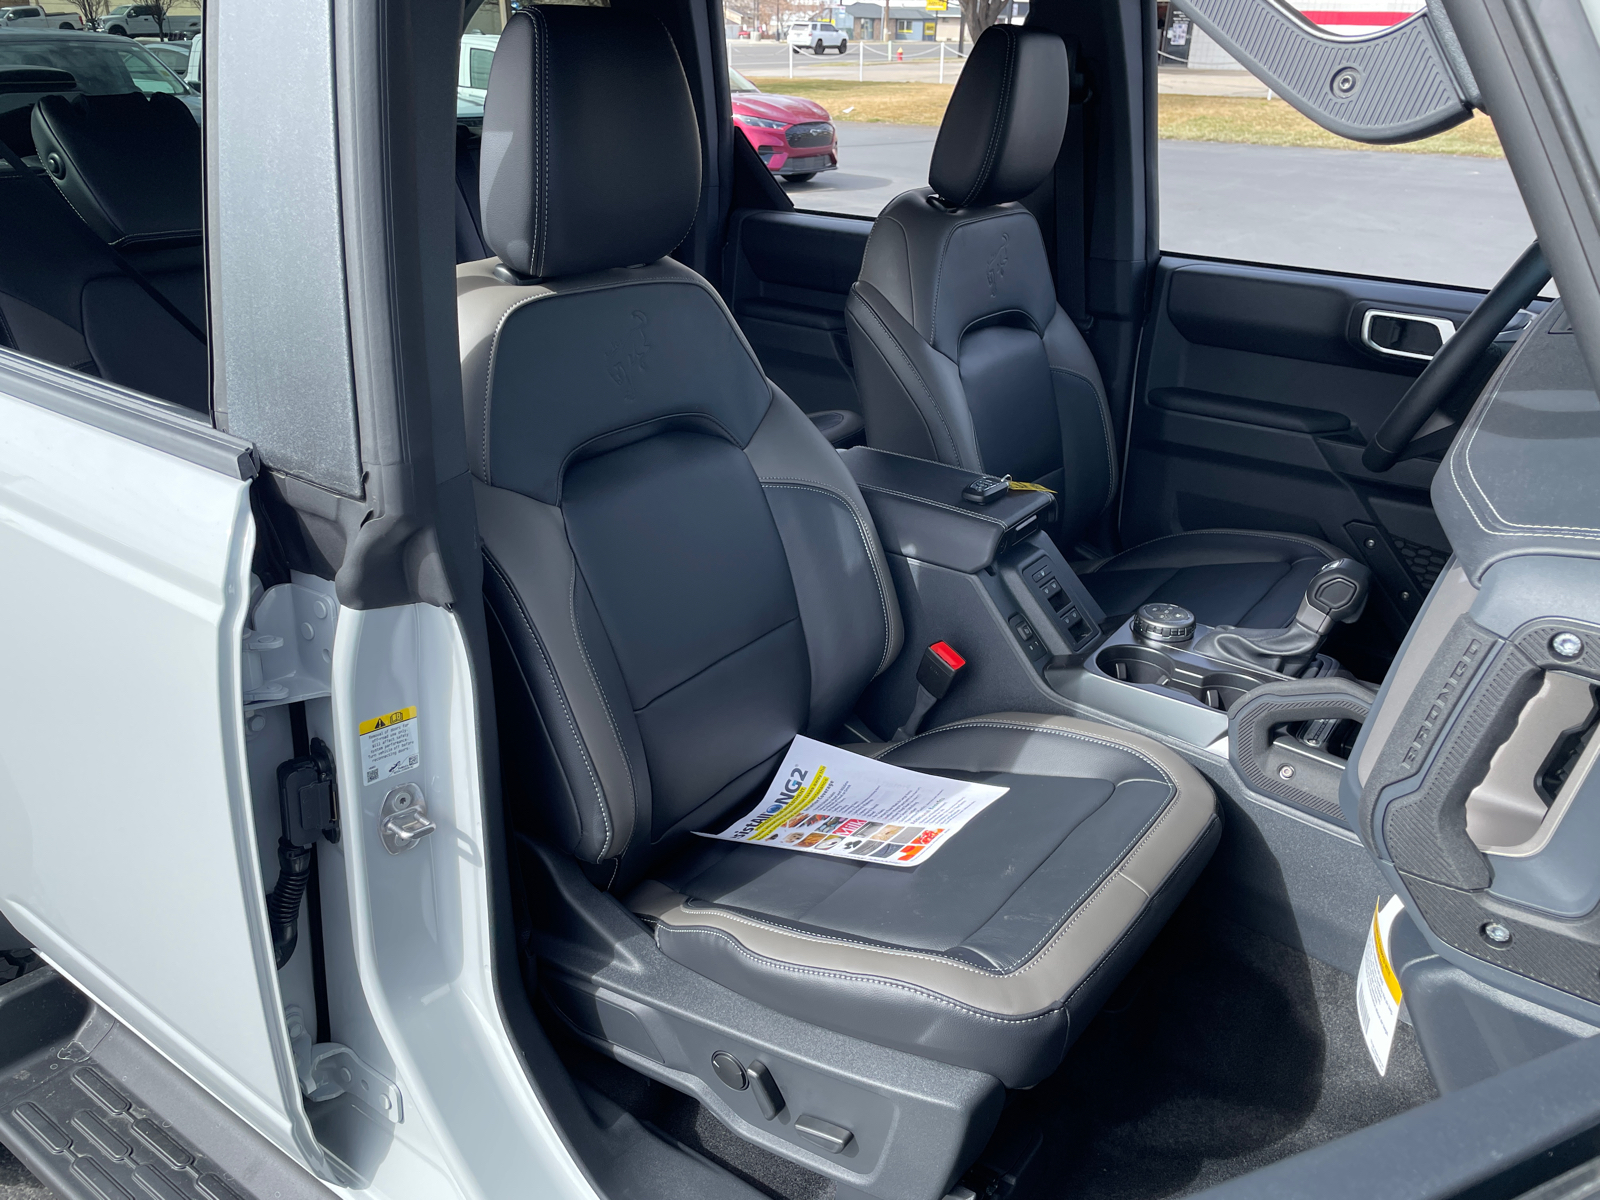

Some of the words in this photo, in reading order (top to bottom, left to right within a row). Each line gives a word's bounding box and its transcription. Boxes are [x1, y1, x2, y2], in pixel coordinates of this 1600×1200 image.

[1401, 638, 1483, 769] BRONCO
[372, 734, 389, 743] off-road
[372, 751, 397, 762] reconnecting
